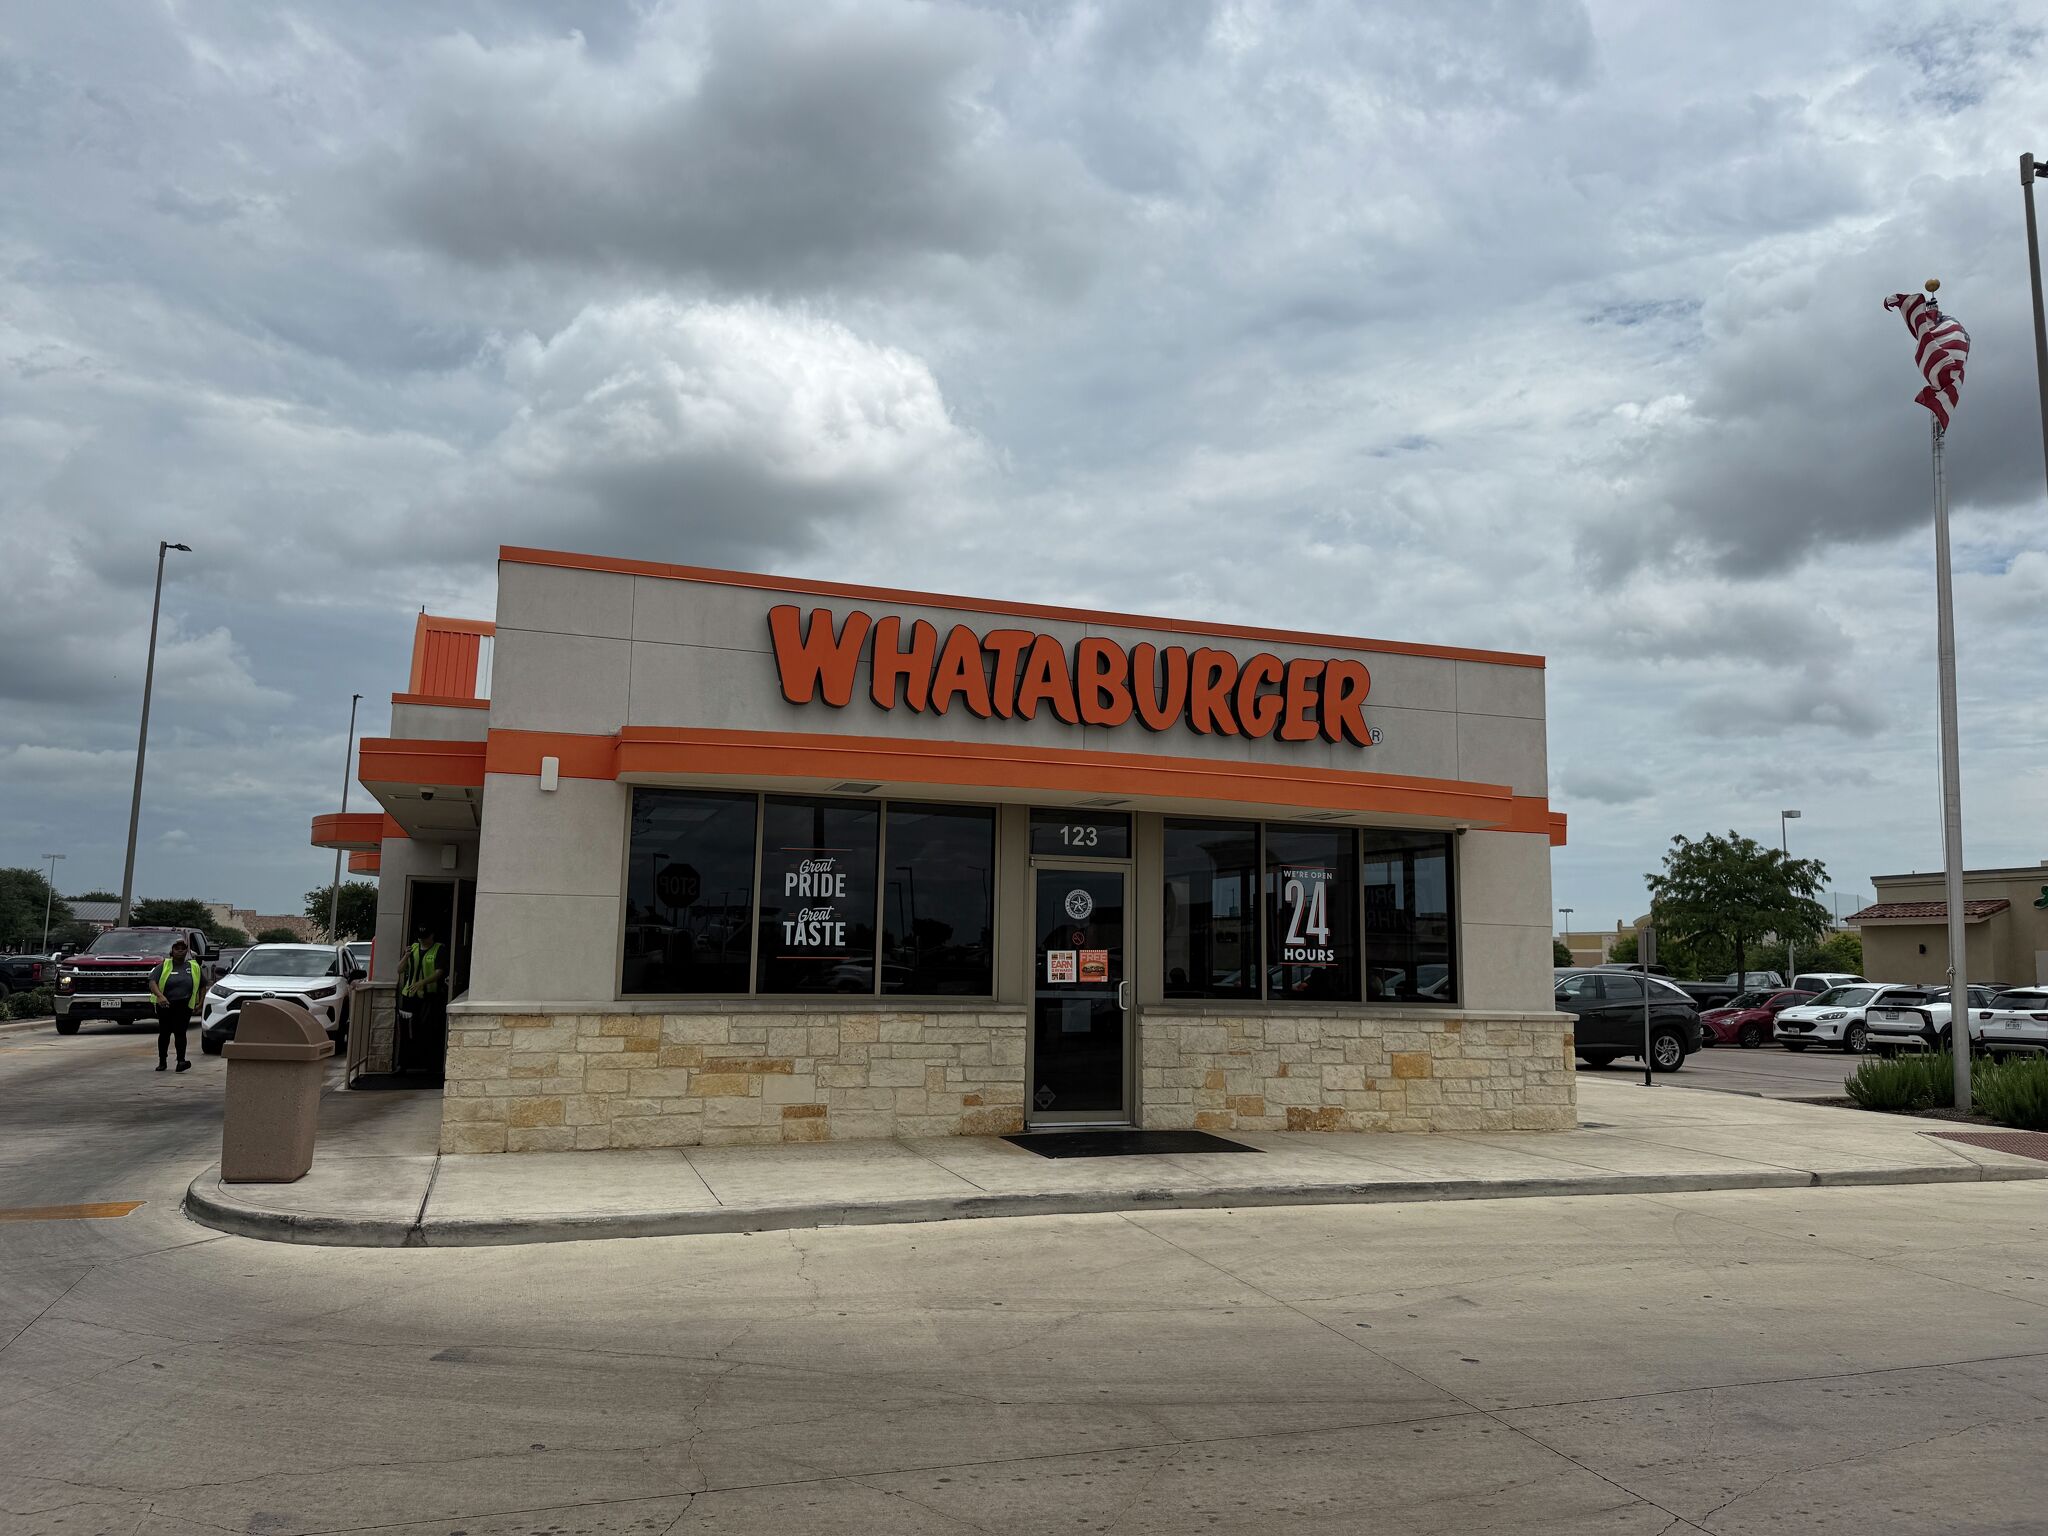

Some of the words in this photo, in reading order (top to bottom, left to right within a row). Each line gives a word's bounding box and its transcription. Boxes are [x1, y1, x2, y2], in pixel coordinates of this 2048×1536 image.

[767, 604, 1372, 747] WHATABURGER
[1060, 826, 1098, 846] 123
[799, 857, 836, 874] Great
[1284, 870, 1309, 880] WE'RE
[1310, 871, 1333, 880] OPEN
[785, 872, 846, 898] PRIDE
[798, 905, 835, 923] Great
[1285, 880, 1331, 945] 24
[783, 921, 846, 946] TASTE
[1051, 960, 1073, 968] EARN
[1080, 953, 1107, 962] FREE
[1284, 948, 1334, 962] HOURS
